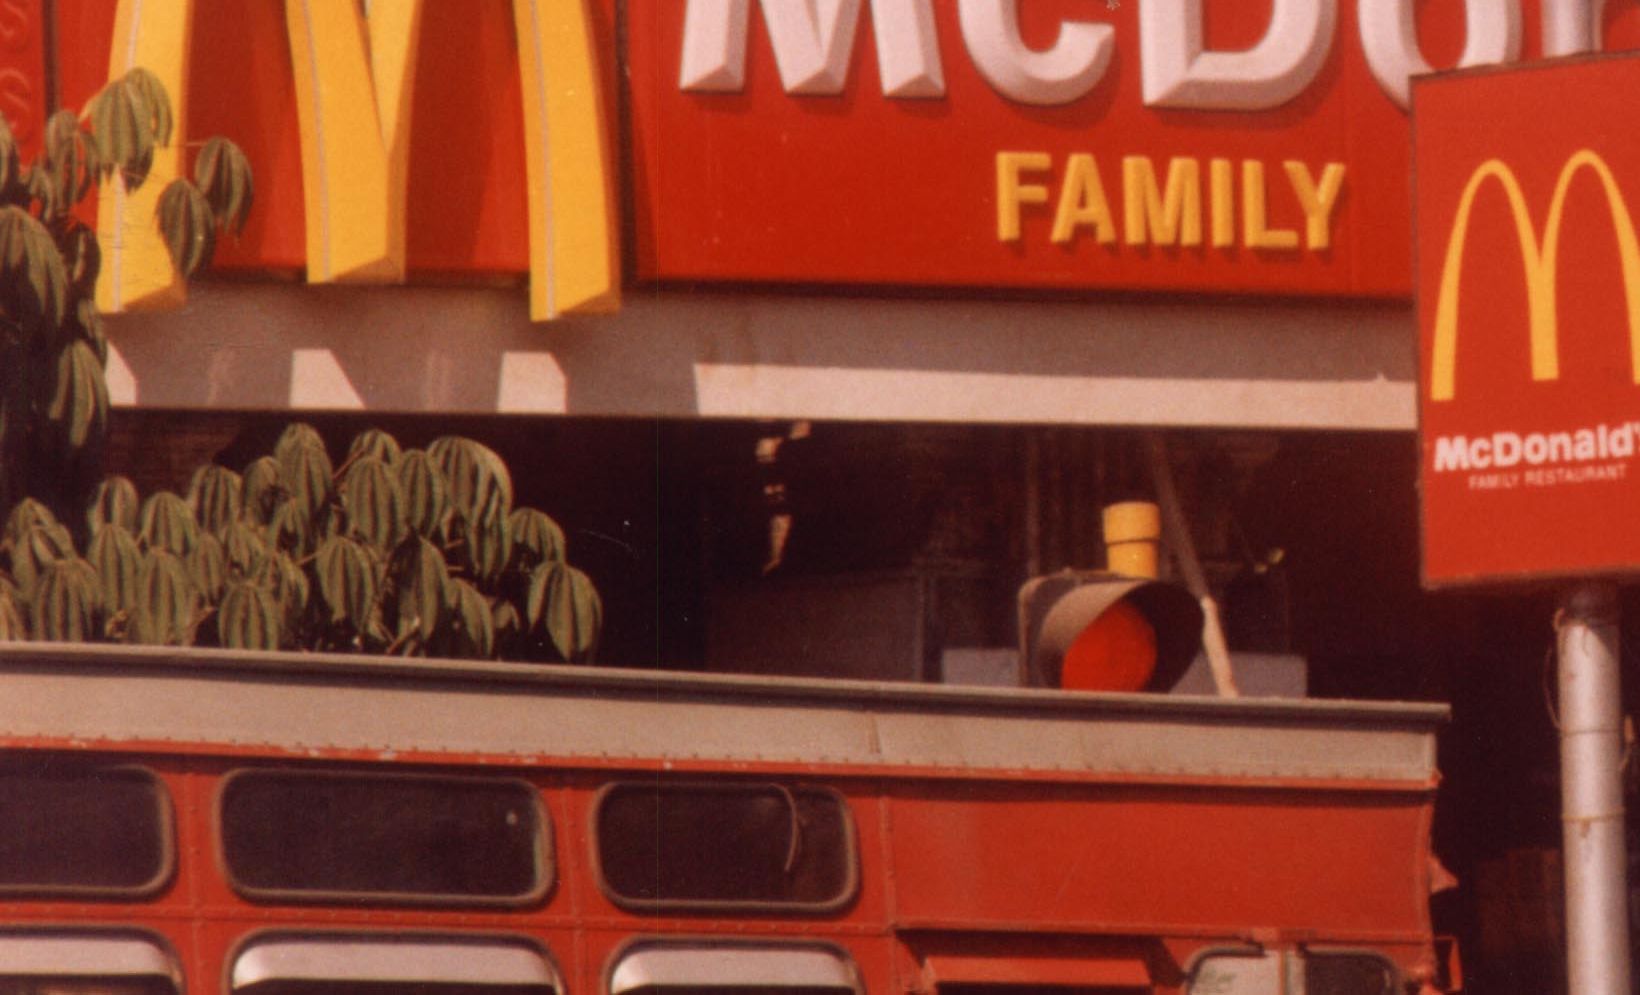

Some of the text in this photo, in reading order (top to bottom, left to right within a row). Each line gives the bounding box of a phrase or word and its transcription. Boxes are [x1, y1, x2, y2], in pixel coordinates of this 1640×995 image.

[995, 151, 1346, 251] FAMILY
[1468, 463, 1628, 490] FAMILY RESTAURANT
